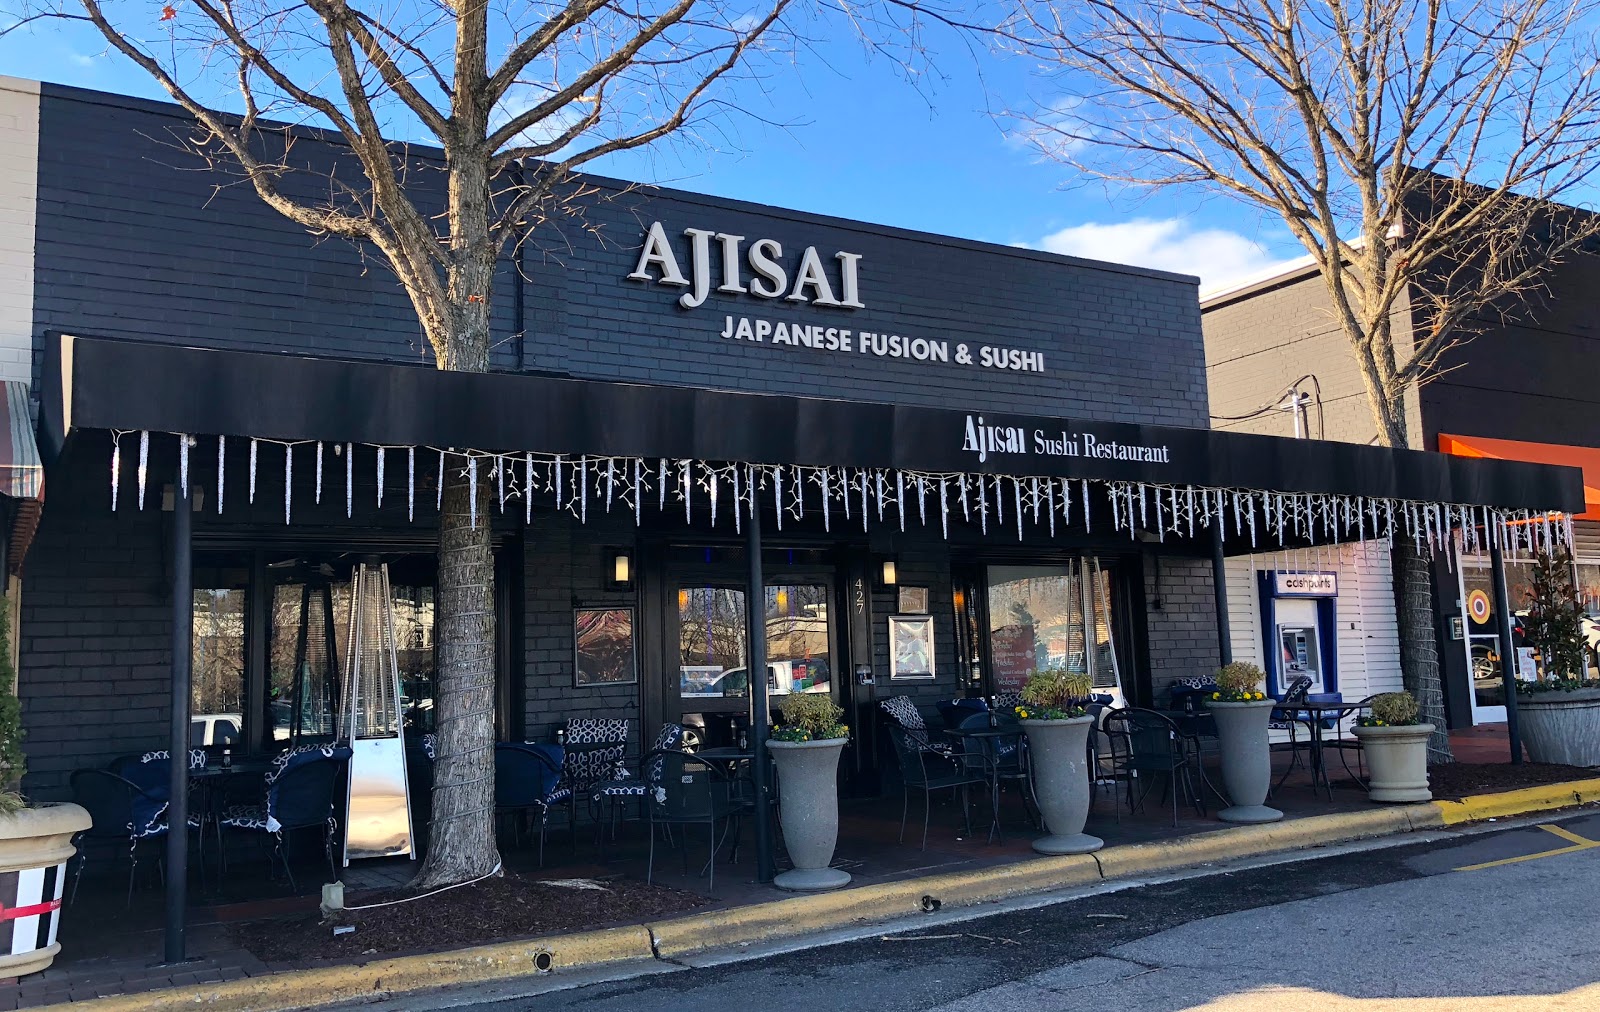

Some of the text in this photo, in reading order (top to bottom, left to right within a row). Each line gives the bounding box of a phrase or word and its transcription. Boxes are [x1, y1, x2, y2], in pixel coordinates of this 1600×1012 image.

[627, 221, 866, 310] AJISAI
[721, 314, 1044, 372] JAPANESE FUSION & SUSHI
[962, 415, 1169, 463] Ajisai Sushi Restaurant
[855, 579, 864, 614] 427
